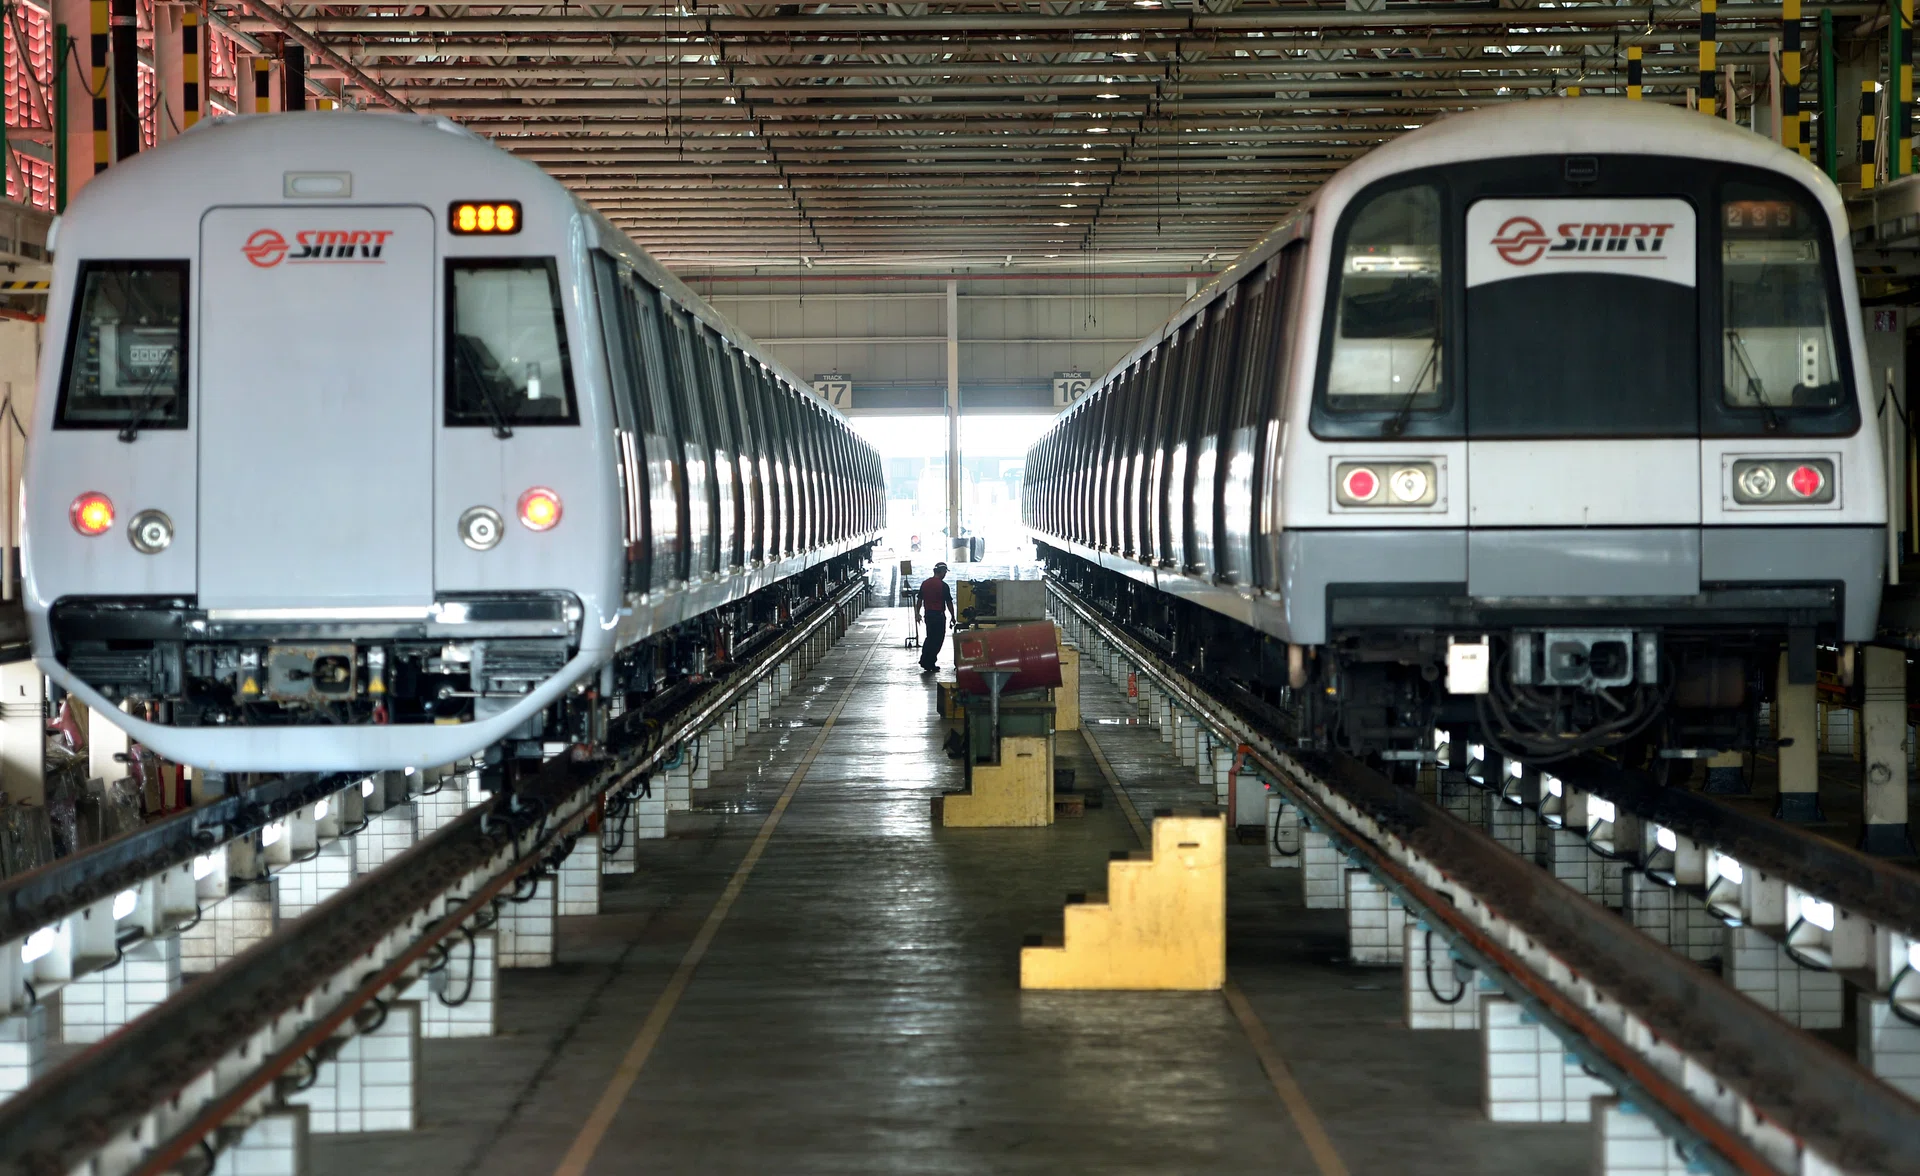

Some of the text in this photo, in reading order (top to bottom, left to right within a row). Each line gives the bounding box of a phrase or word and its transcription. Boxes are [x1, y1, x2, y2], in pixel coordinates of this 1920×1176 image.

[288, 230, 394, 258] SMRT
[1549, 223, 1674, 251] SMRT
[818, 384, 847, 405] 17
[1058, 381, 1086, 403] 16
